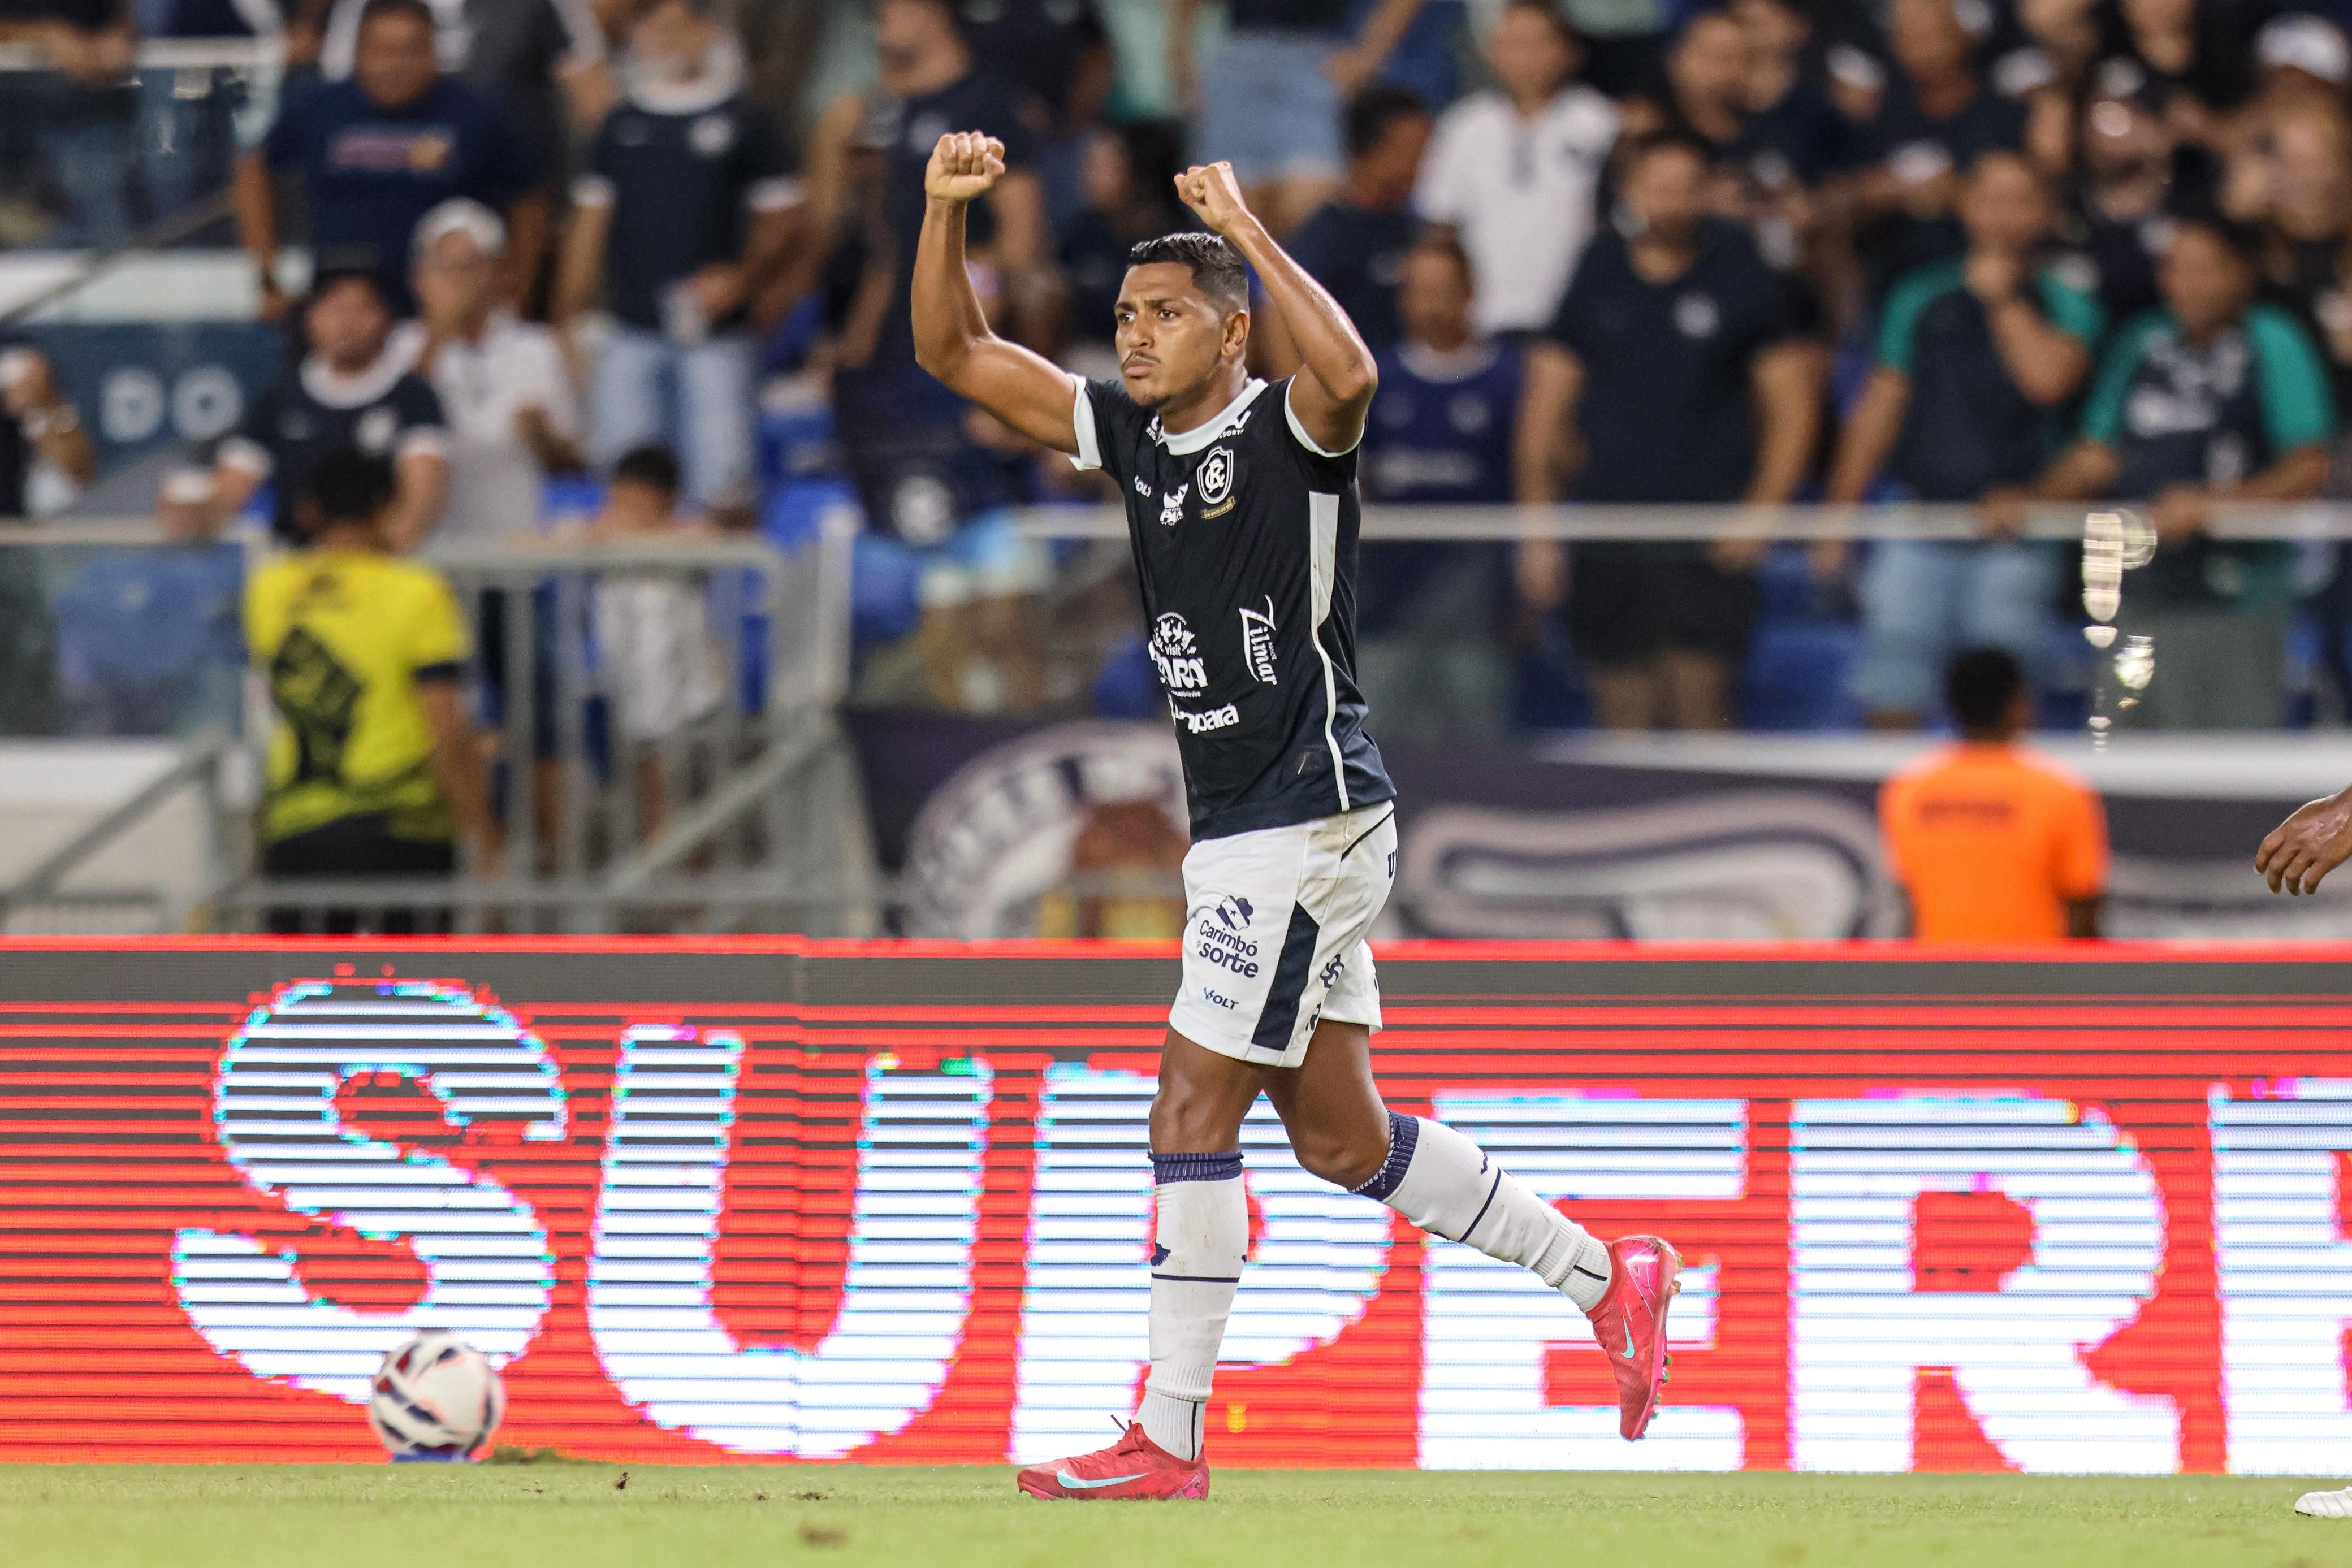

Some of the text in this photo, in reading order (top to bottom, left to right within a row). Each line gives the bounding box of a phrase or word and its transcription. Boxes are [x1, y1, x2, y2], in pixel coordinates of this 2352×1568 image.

[1239, 594, 1278, 686] Zilmar
[1200, 920, 1258, 956] Carimbó
[1199, 943, 1259, 978] sorte
[1203, 987, 1239, 1010] VOLT
